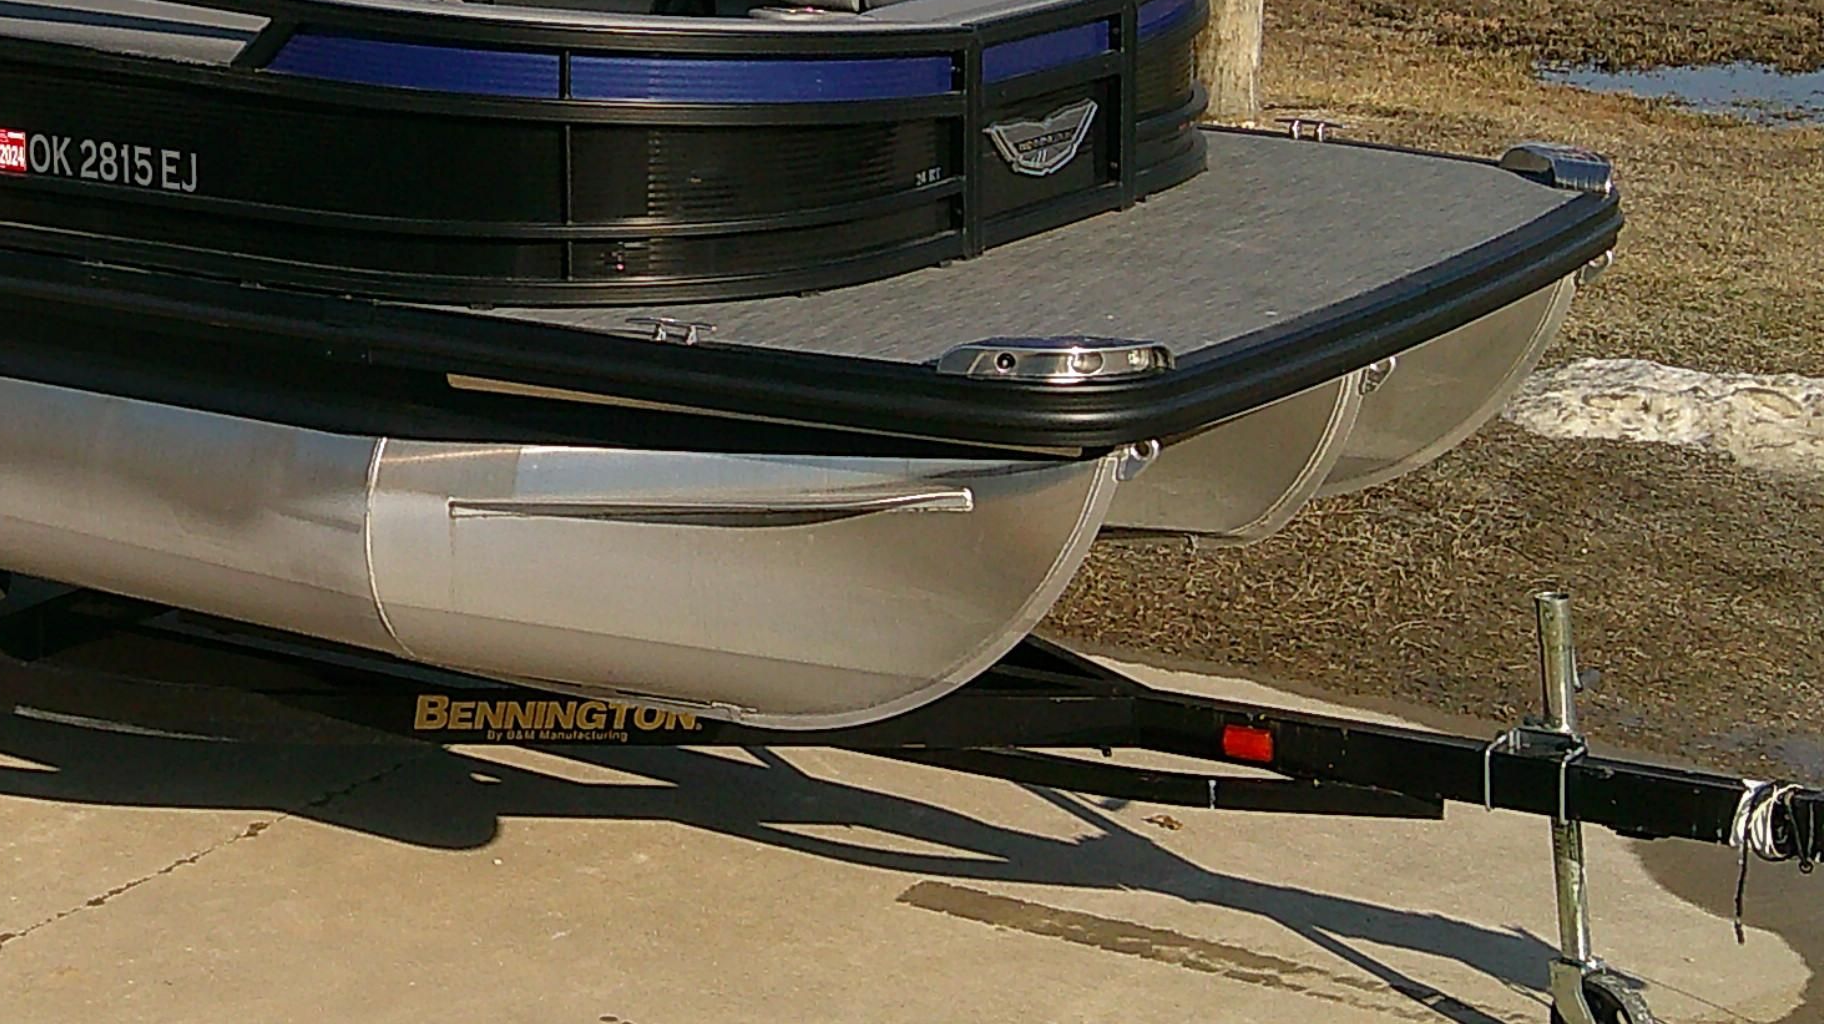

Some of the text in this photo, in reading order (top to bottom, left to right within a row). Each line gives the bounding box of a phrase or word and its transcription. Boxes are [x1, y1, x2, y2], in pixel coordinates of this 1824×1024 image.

[29, 133, 197, 193] OK 2815 EJ
[414, 694, 696, 731] BENNINGTON
[538, 730, 629, 742] Manufacturing
